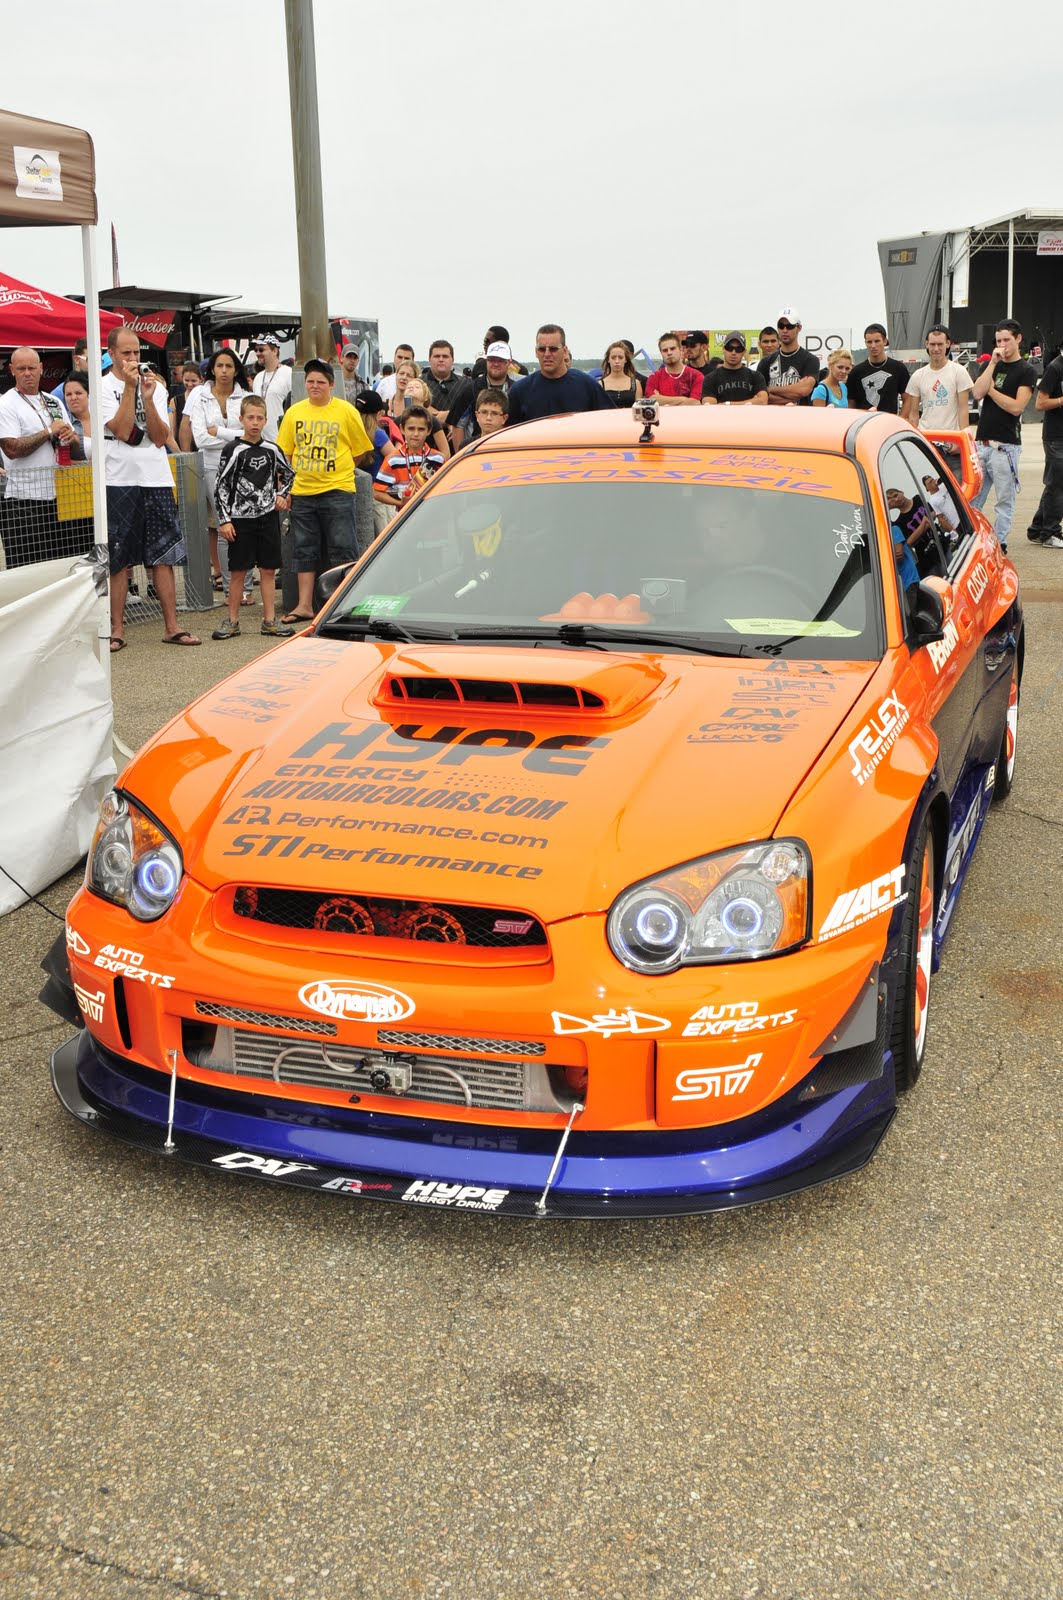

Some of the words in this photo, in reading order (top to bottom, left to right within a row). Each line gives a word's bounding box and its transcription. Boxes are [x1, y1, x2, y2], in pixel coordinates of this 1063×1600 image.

[123, 315, 175, 334] udweiser
[717, 380, 754, 394] OAKLEY
[296, 420, 340, 436] PUMA
[296, 433, 338, 449] PUMA
[296, 459, 336, 472] PUMA
[708, 459, 816, 476] EXPERTS
[717, 453, 777, 465] AUTO
[832, 523, 853, 558] Daily
[850, 508, 866, 549] Driven
[363, 599, 401, 610] HYPE
[288, 721, 613, 776] HYPE
[856, 750, 883, 786] RACING
[880, 709, 910, 755] SUSPENSION
[274, 764, 429, 782] ENERGY
[241, 779, 568, 821] AUTOAIRCOLORS.COM
[276, 811, 549, 849] Performance.com
[223, 834, 307, 857] STI
[298, 843, 544, 880] Performance
[818, 921, 855, 943] ADVANCED
[855, 910, 879, 926] CLUTCH
[98, 943, 145, 966] AUTO
[93, 955, 176, 989] EXPERTS
[681, 1008, 798, 1037] EXPERTS
[689, 1001, 759, 1021] AUTO
[551, 1009, 672, 1038] D&D
[401, 1194, 456, 1206] ENERGY
[455, 1199, 500, 1211] DRINK
[404, 1180, 510, 1205] HYPE
